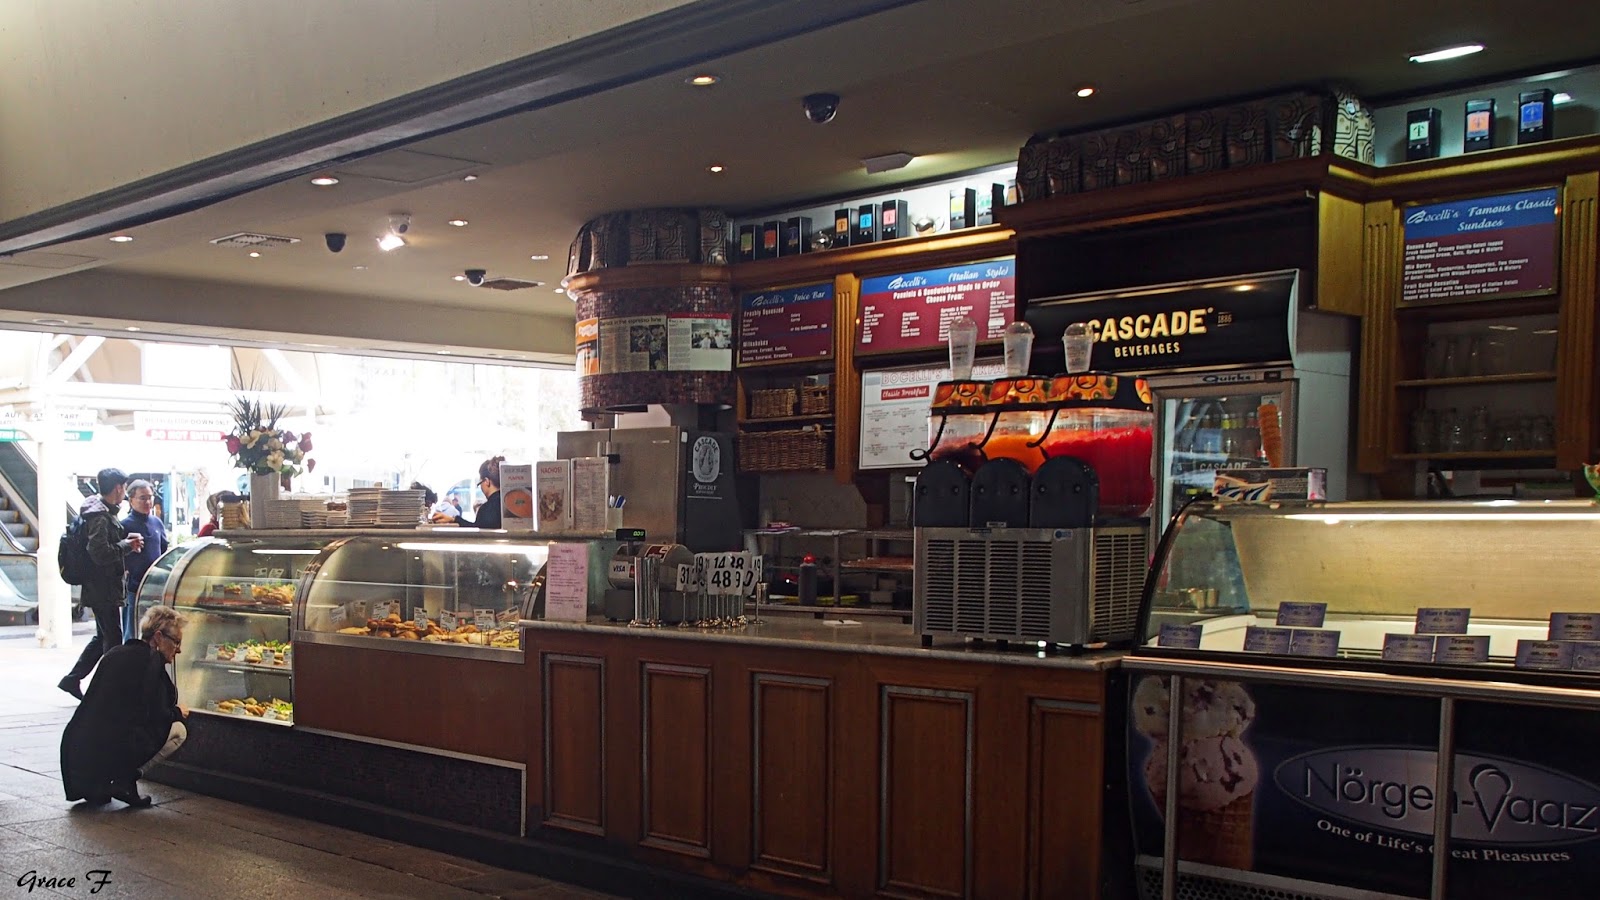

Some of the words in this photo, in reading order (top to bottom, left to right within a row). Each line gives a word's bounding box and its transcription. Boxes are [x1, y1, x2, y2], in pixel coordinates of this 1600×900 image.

[1407, 209, 1460, 225] Bocelli's
[1468, 205, 1513, 217] Famous
[1515, 197, 1556, 211] Classic
[1458, 219, 1505, 232] Sundaes
[888, 276, 927, 290] Bocelli's
[949, 270, 979, 282] (Italian
[986, 266, 1009, 279] Style)
[923, 285, 956, 296] Sandwiches
[958, 283, 973, 292] Made
[975, 282, 981, 290] to
[982, 280, 1000, 289] Order
[793, 292, 810, 302] Juice
[812, 291, 825, 299] Bar
[926, 295, 947, 304] Choose
[948, 292, 965, 302] From:
[744, 309, 761, 317] Freshly
[1087, 309, 1208, 343] CASCADE
[1115, 342, 1180, 358] BEVERAGES
[882, 369, 944, 384] BOCELLI'S
[882, 390, 900, 398] Classic
[168, 431, 188, 440] NOT
[1200, 462, 1249, 471] CASCADE
[681, 567, 690, 584] 31
[712, 570, 731, 588] 48
[1305, 760, 1598, 834] Nörge-Vaaz
[1317, 819, 1351, 838] One
[1355, 831, 1371, 843] of
[1377, 835, 1424, 854] Life's
[1483, 849, 1571, 863] Pleasures
